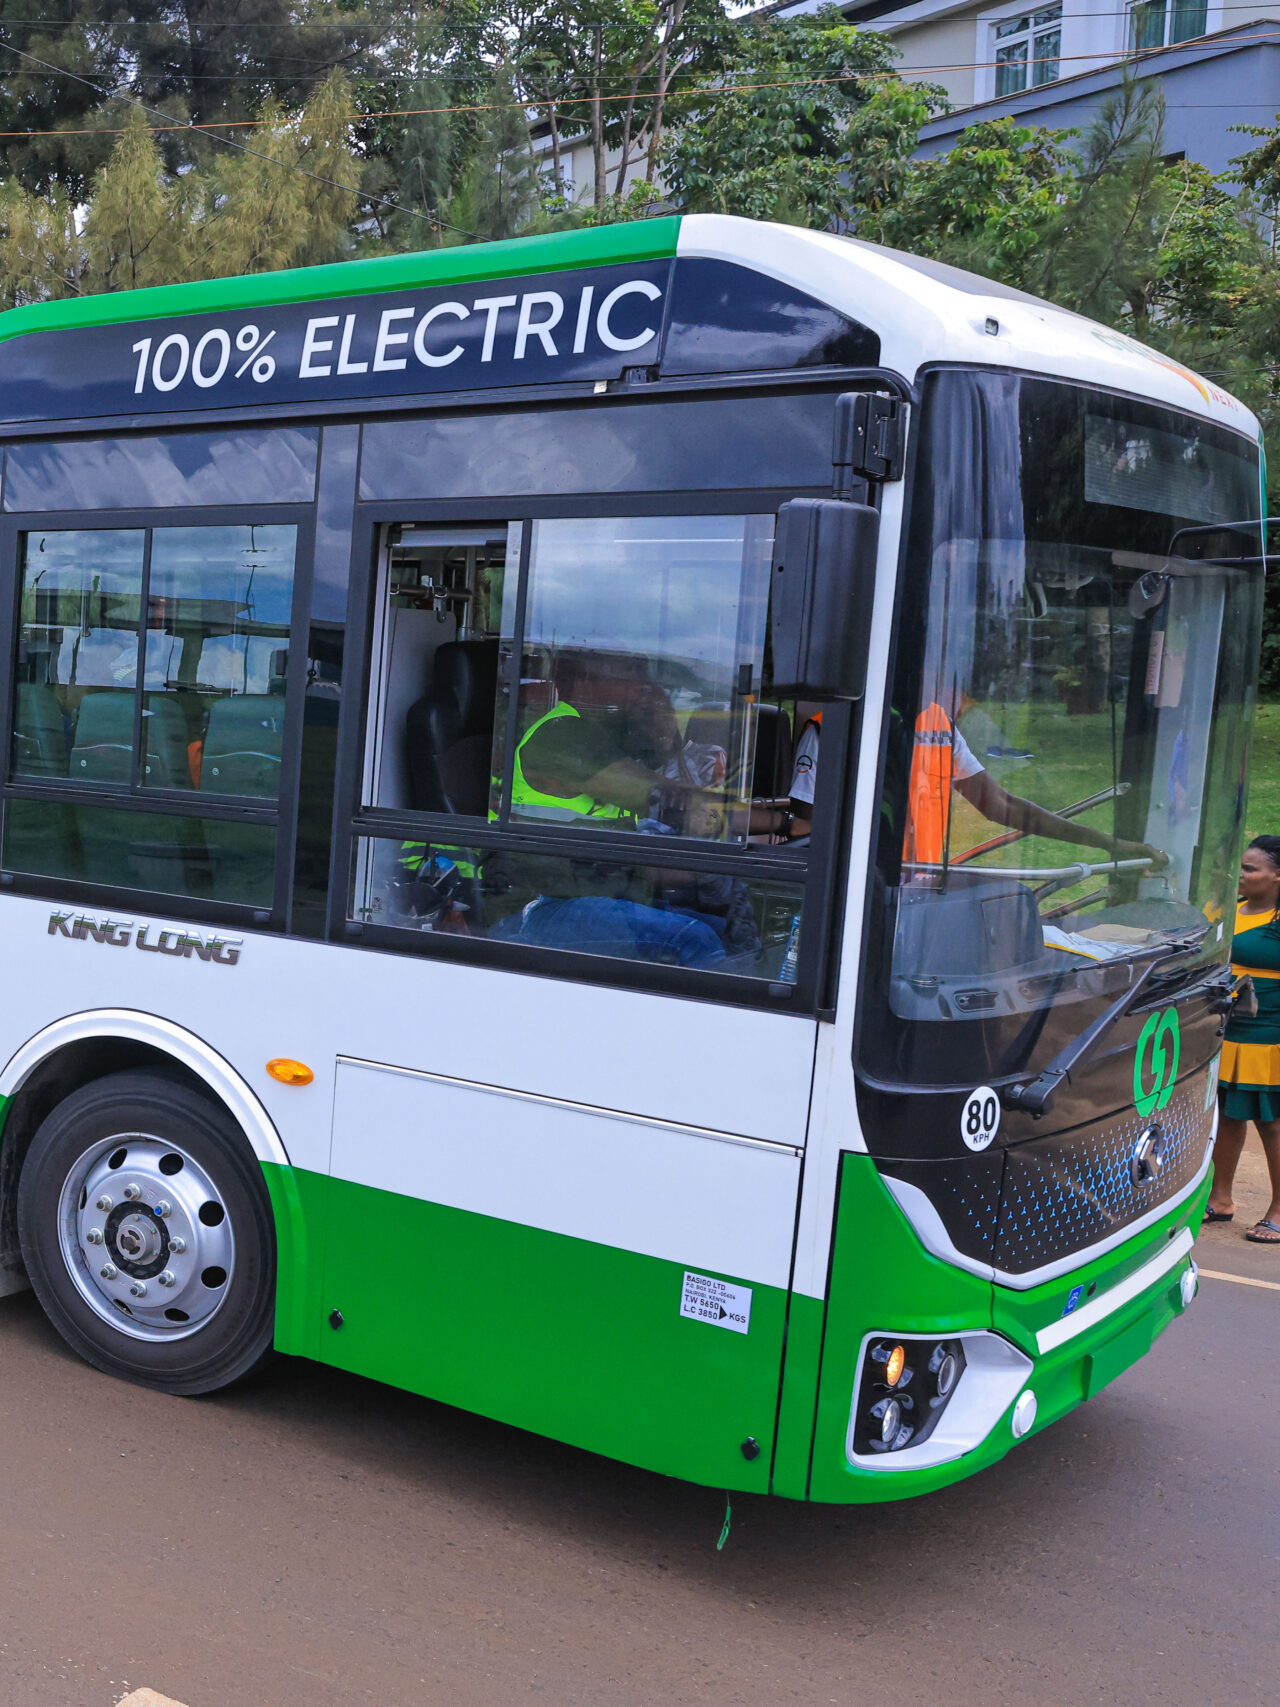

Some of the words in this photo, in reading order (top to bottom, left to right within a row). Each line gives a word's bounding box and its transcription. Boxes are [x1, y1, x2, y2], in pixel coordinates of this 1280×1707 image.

[132, 323, 276, 394] 100%
[298, 280, 663, 378] ELECTRIC
[47, 908, 135, 948] KING
[136, 923, 244, 966] LONG
[967, 1097, 996, 1135] 80
[973, 1133, 989, 1144] KPH
[686, 1275, 711, 1287] BASIGO
[713, 1282, 726, 1291] LTD
[696, 1284, 707, 1292] BOX
[685, 1294, 699, 1304] T.W
[700, 1298, 719, 1310] 5650
[683, 1304, 696, 1313] L.C
[698, 1308, 718, 1320] 3850
[729, 1312, 746, 1323] KGS
